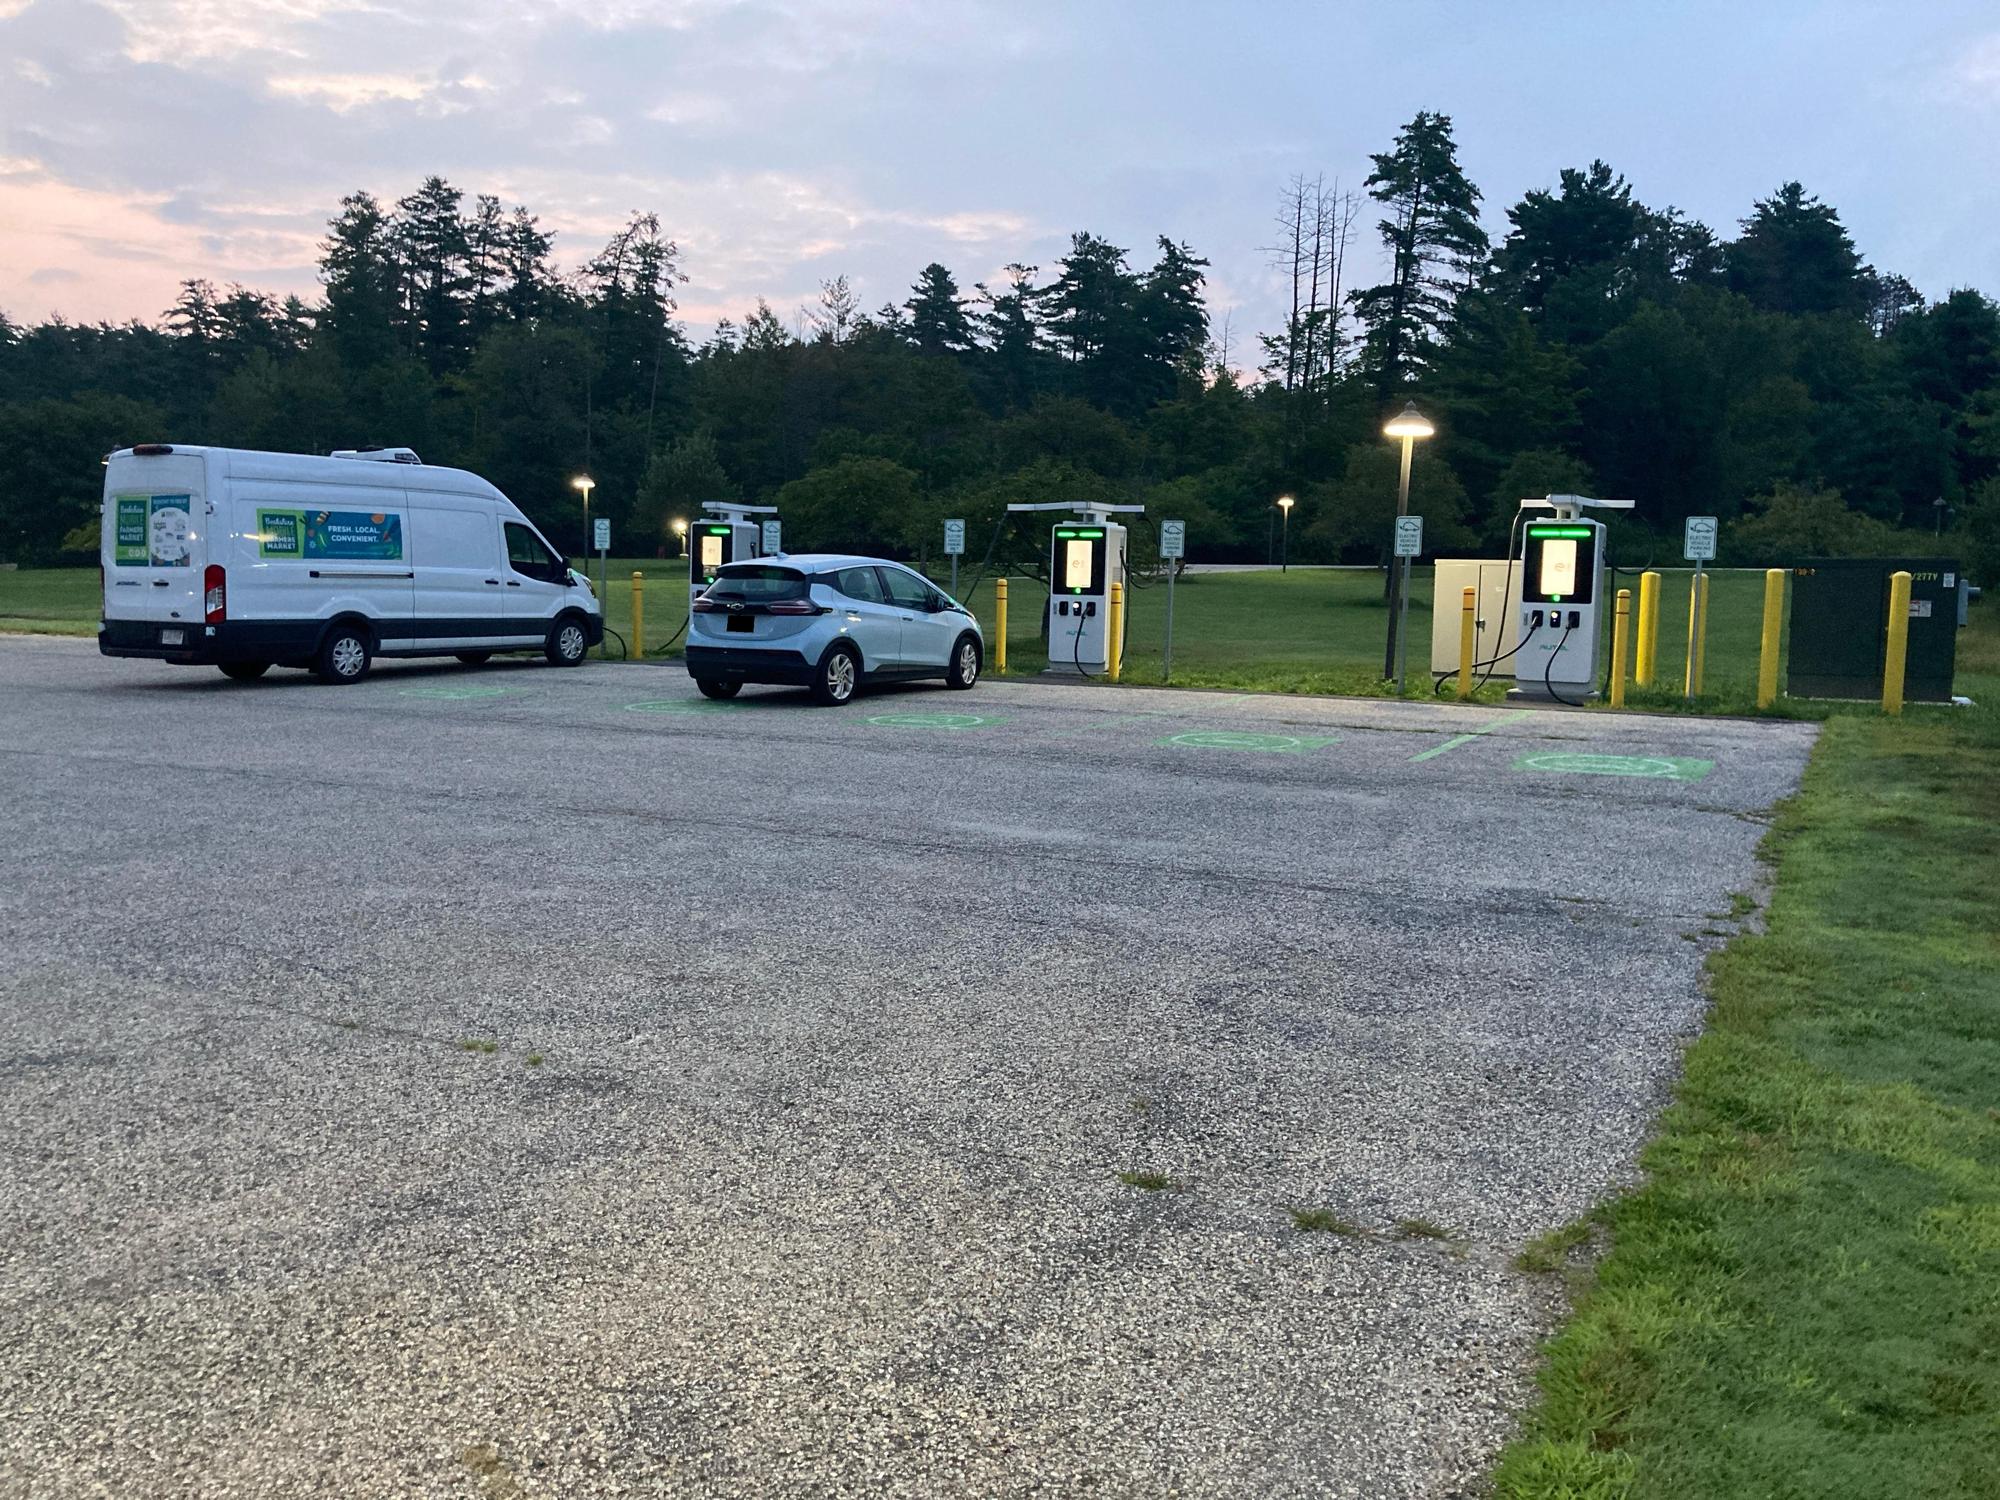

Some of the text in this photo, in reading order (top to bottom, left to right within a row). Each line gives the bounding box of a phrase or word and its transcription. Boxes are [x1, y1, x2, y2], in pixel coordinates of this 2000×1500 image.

[327, 525, 381, 534] FRESH. LOCAL.
[331, 535, 379, 543] CONVENIENT.
